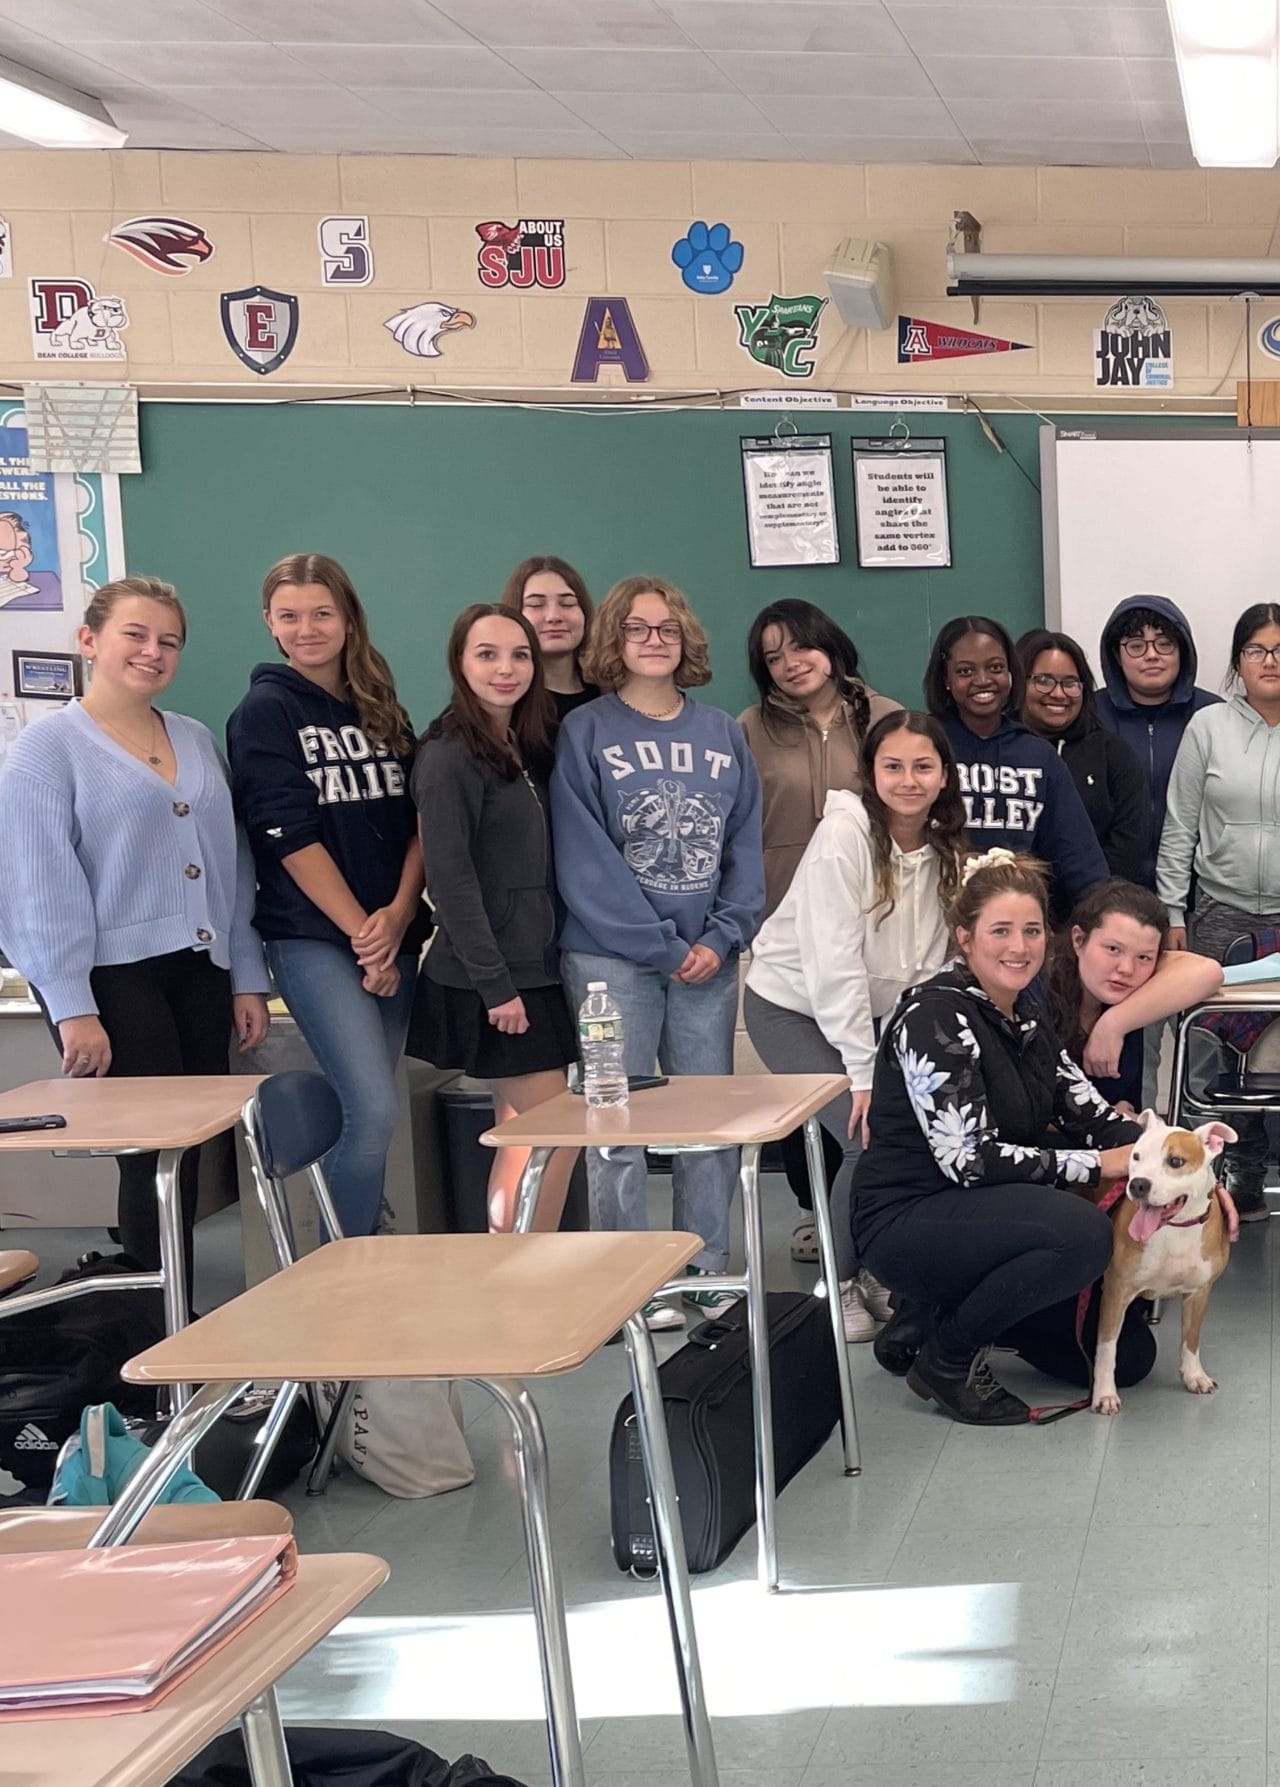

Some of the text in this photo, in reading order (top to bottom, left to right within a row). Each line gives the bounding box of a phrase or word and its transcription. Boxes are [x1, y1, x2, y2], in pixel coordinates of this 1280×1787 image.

[519, 221, 562, 234] ABOUT
[544, 235, 562, 246] US
[320, 219, 370, 283] S
[480, 246, 565, 287] SJU
[32, 280, 93, 333] D
[772, 304, 813, 316] SPARTANS
[244, 302, 277, 351] E
[570, 297, 649, 382] A
[902, 326, 932, 355] A
[937, 336, 998, 351] WILDCATS
[1096, 330, 1171, 358] JOHN
[1097, 357, 1146, 385] JAY
[744, 396, 832, 405] Content Objective
[915, 472, 934, 480] will
[22, 482, 46, 490] THE
[878, 484, 890, 492] be
[882, 496, 923, 505] identify
[911, 520, 928, 528] the
[902, 532, 936, 540] vertex
[877, 543, 897, 551] add
[602, 741, 731, 781] SOOT
[956, 762, 1043, 798] ROST
[961, 796, 1044, 831] LLEY
[14, 1441, 60, 1450] adidas
